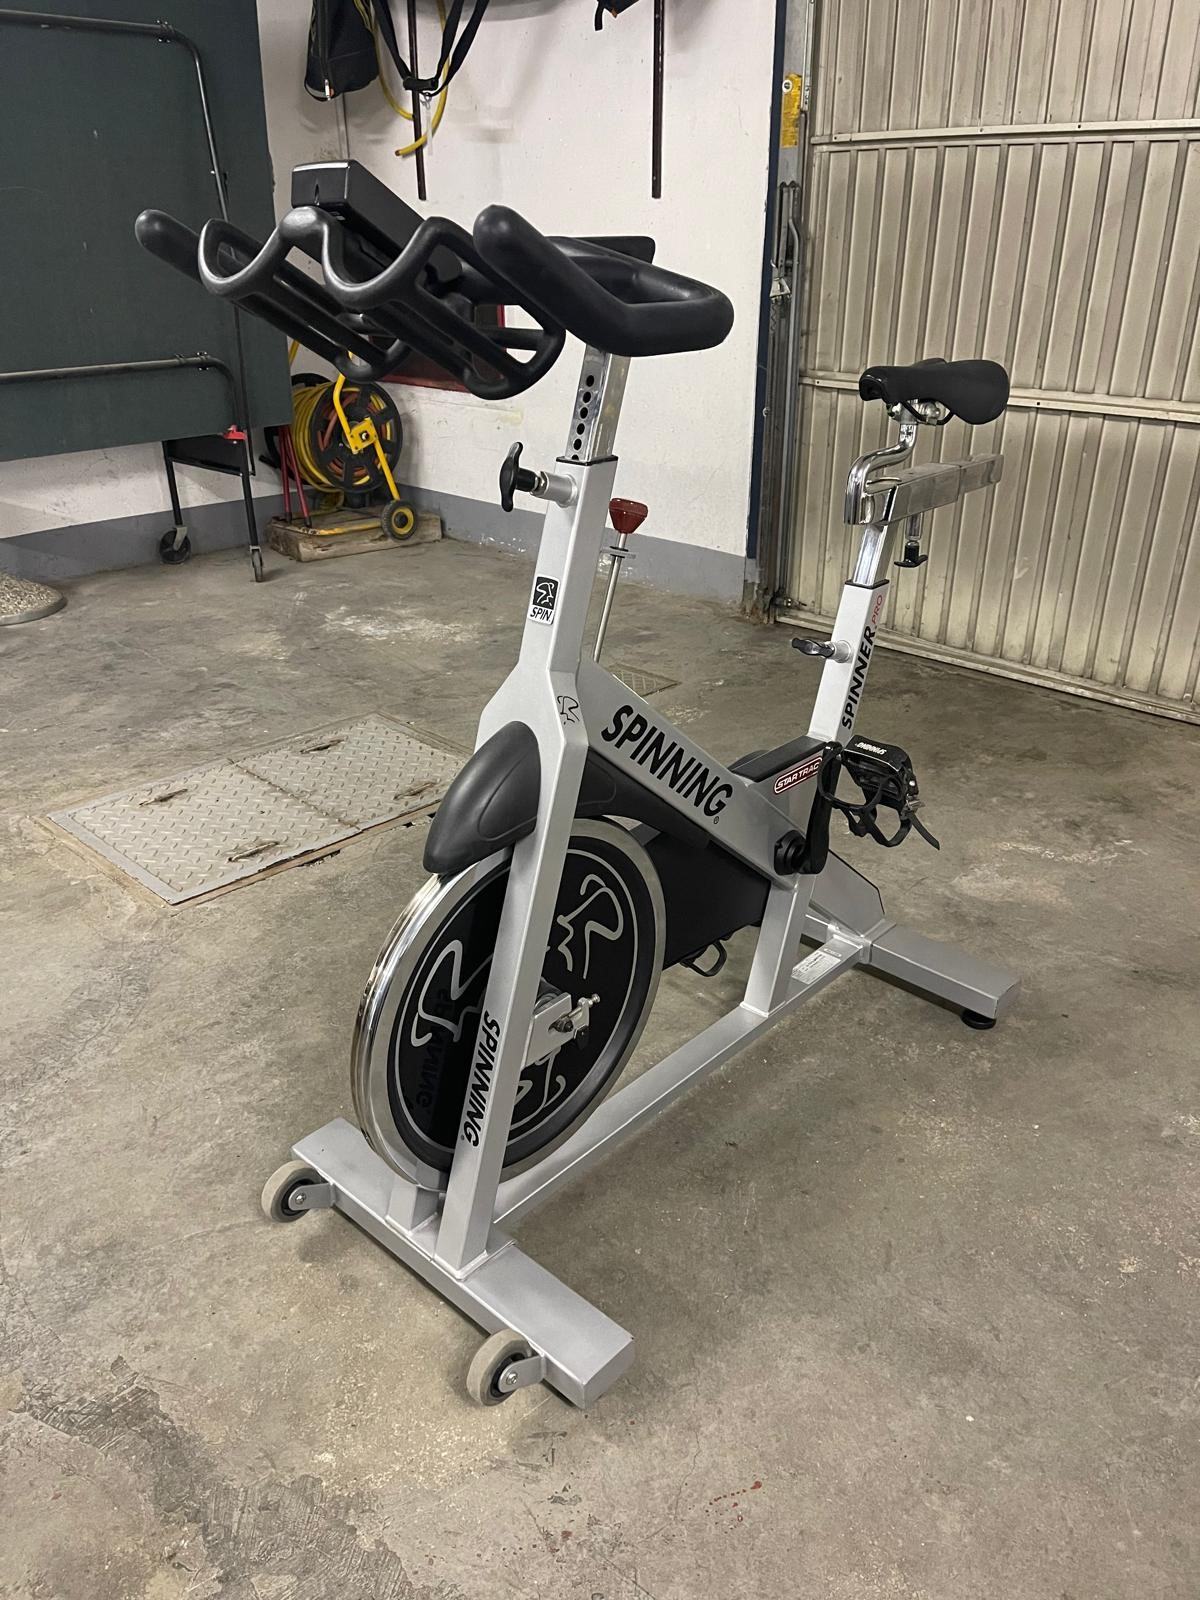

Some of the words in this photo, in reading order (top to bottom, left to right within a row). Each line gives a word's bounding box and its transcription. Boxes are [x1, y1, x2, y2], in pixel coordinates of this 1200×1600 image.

[529, 606, 553, 622] SPIN
[841, 625, 876, 730] SPINNER
[871, 594, 883, 625] PRO
[776, 772, 798, 789] STAR
[797, 761, 820, 778] TRAC
[463, 1010, 501, 1147] SPINNING
